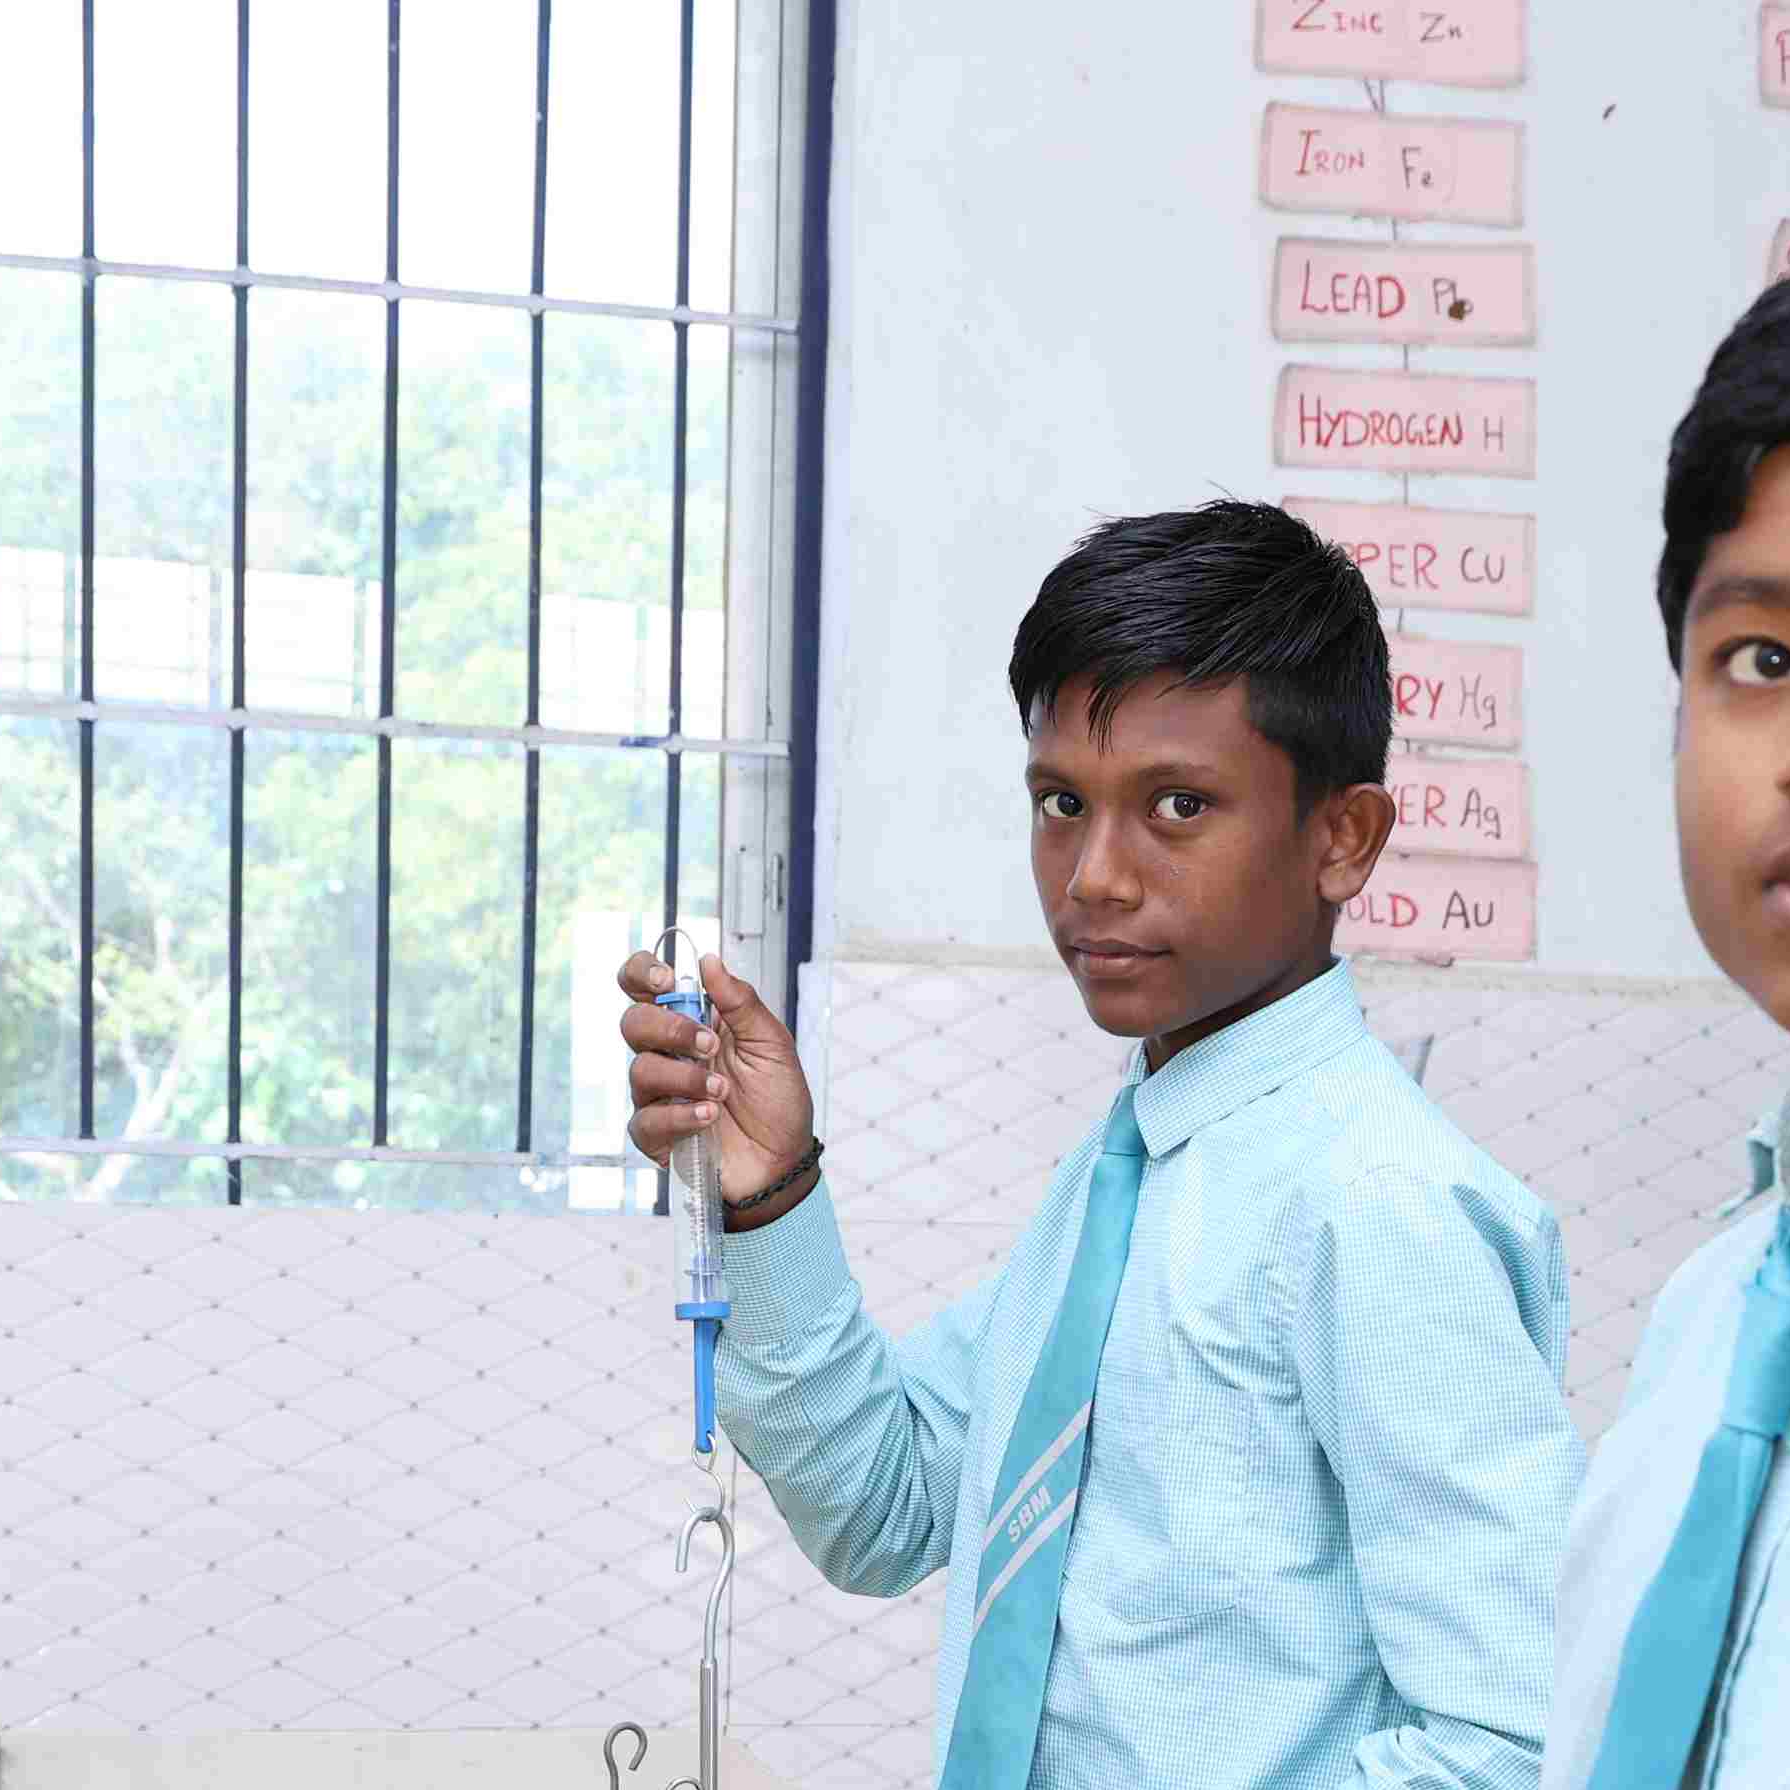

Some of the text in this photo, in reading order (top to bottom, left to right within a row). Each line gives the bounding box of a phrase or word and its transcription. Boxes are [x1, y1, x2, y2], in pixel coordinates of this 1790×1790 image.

[1294, 129, 1434, 189] IRON Fe
[1300, 259, 1405, 319] LEAD
[1299, 392, 1504, 452] HYDROGEN H
[1460, 674, 1497, 731] Hg
[1460, 787, 1501, 840] Ag
[1345, 889, 1494, 929] OLD Au
[1008, 1485, 1051, 1543] SBM
